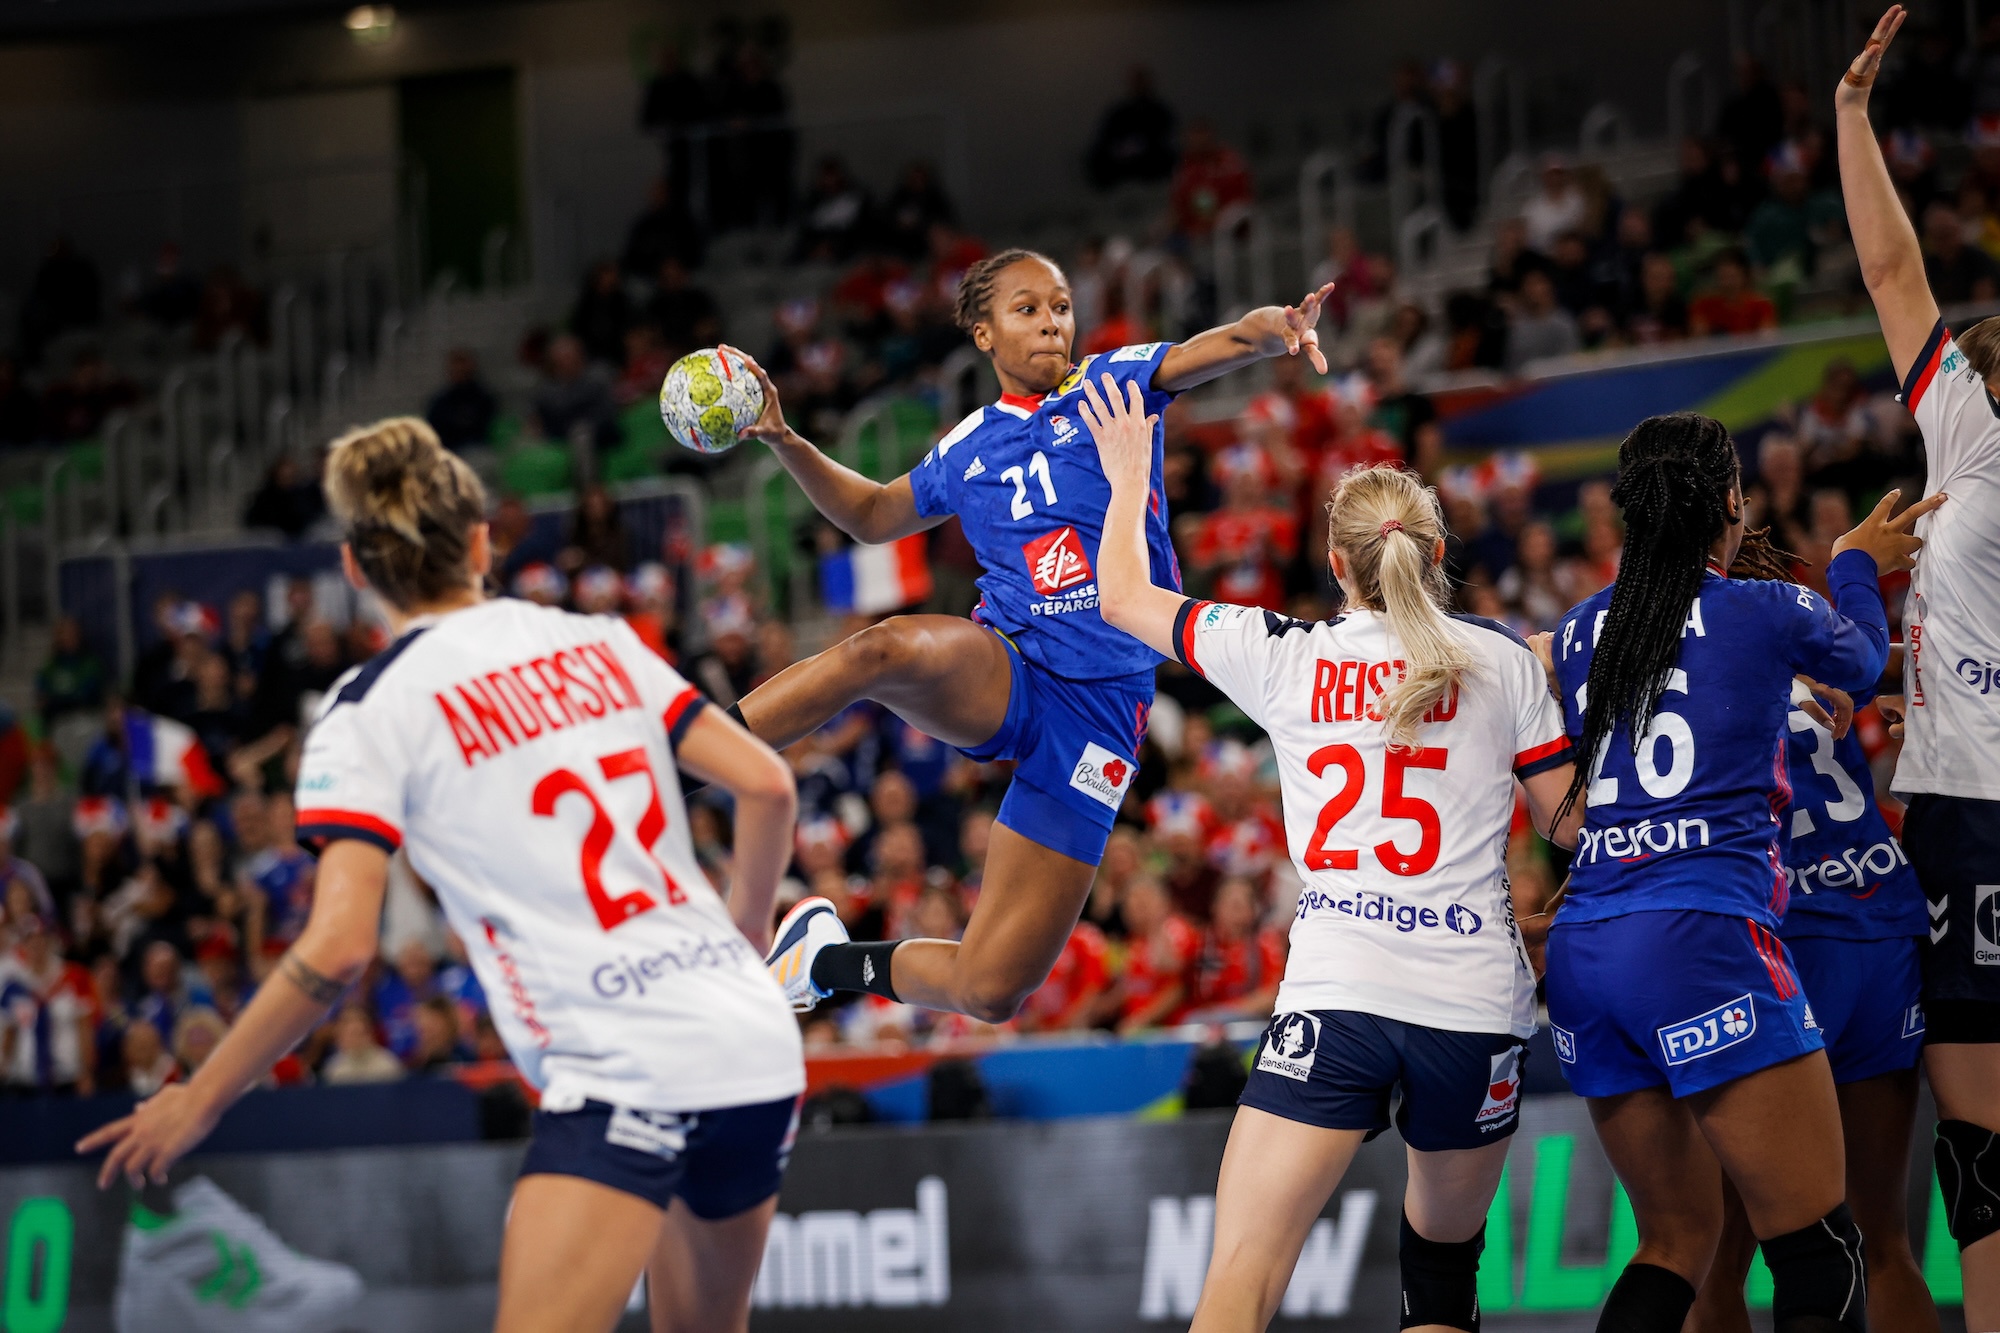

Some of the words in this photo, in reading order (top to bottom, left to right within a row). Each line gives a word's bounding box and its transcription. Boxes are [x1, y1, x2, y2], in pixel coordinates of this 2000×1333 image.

[1000, 450, 1057, 521] 21
[434, 641, 644, 768] ANDERSEN
[1304, 743, 1449, 877] 25
[1788, 709, 1866, 839] 3
[531, 747, 689, 932] 27
[1665, 1018, 1719, 1057] FDJ
[1140, 1192, 1378, 1318] NW
